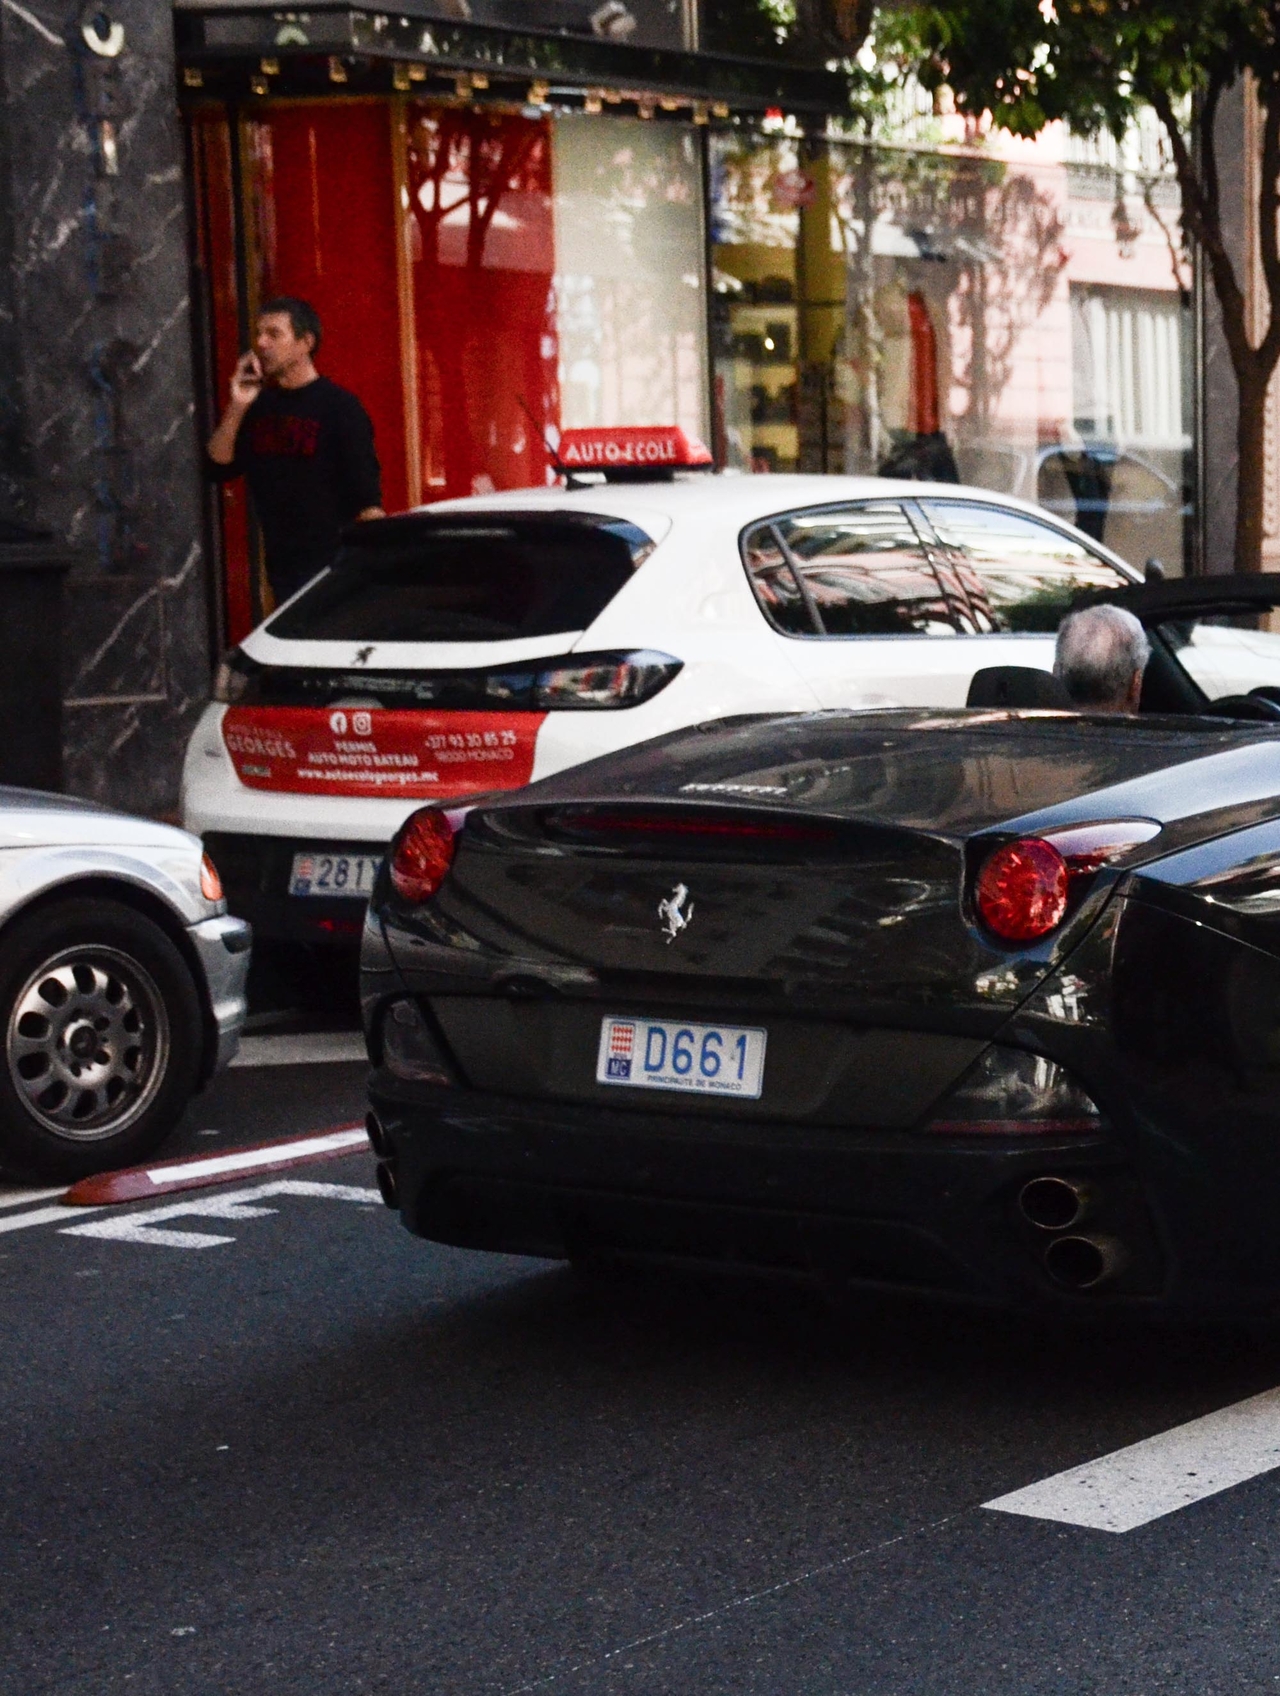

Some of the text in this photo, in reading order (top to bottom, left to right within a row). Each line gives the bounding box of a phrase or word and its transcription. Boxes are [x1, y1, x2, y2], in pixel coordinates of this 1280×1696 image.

[226, 732, 297, 759] GEORGES
[334, 740, 377, 753] PERMIS
[307, 751, 419, 767] AUTO MOTO BATEAU
[467, 747, 515, 762] MONACO
[643, 1025, 748, 1080] D661
[610, 1059, 628, 1076] MC
[695, 1078, 707, 1088] DE
[709, 1080, 742, 1091] MONACO
